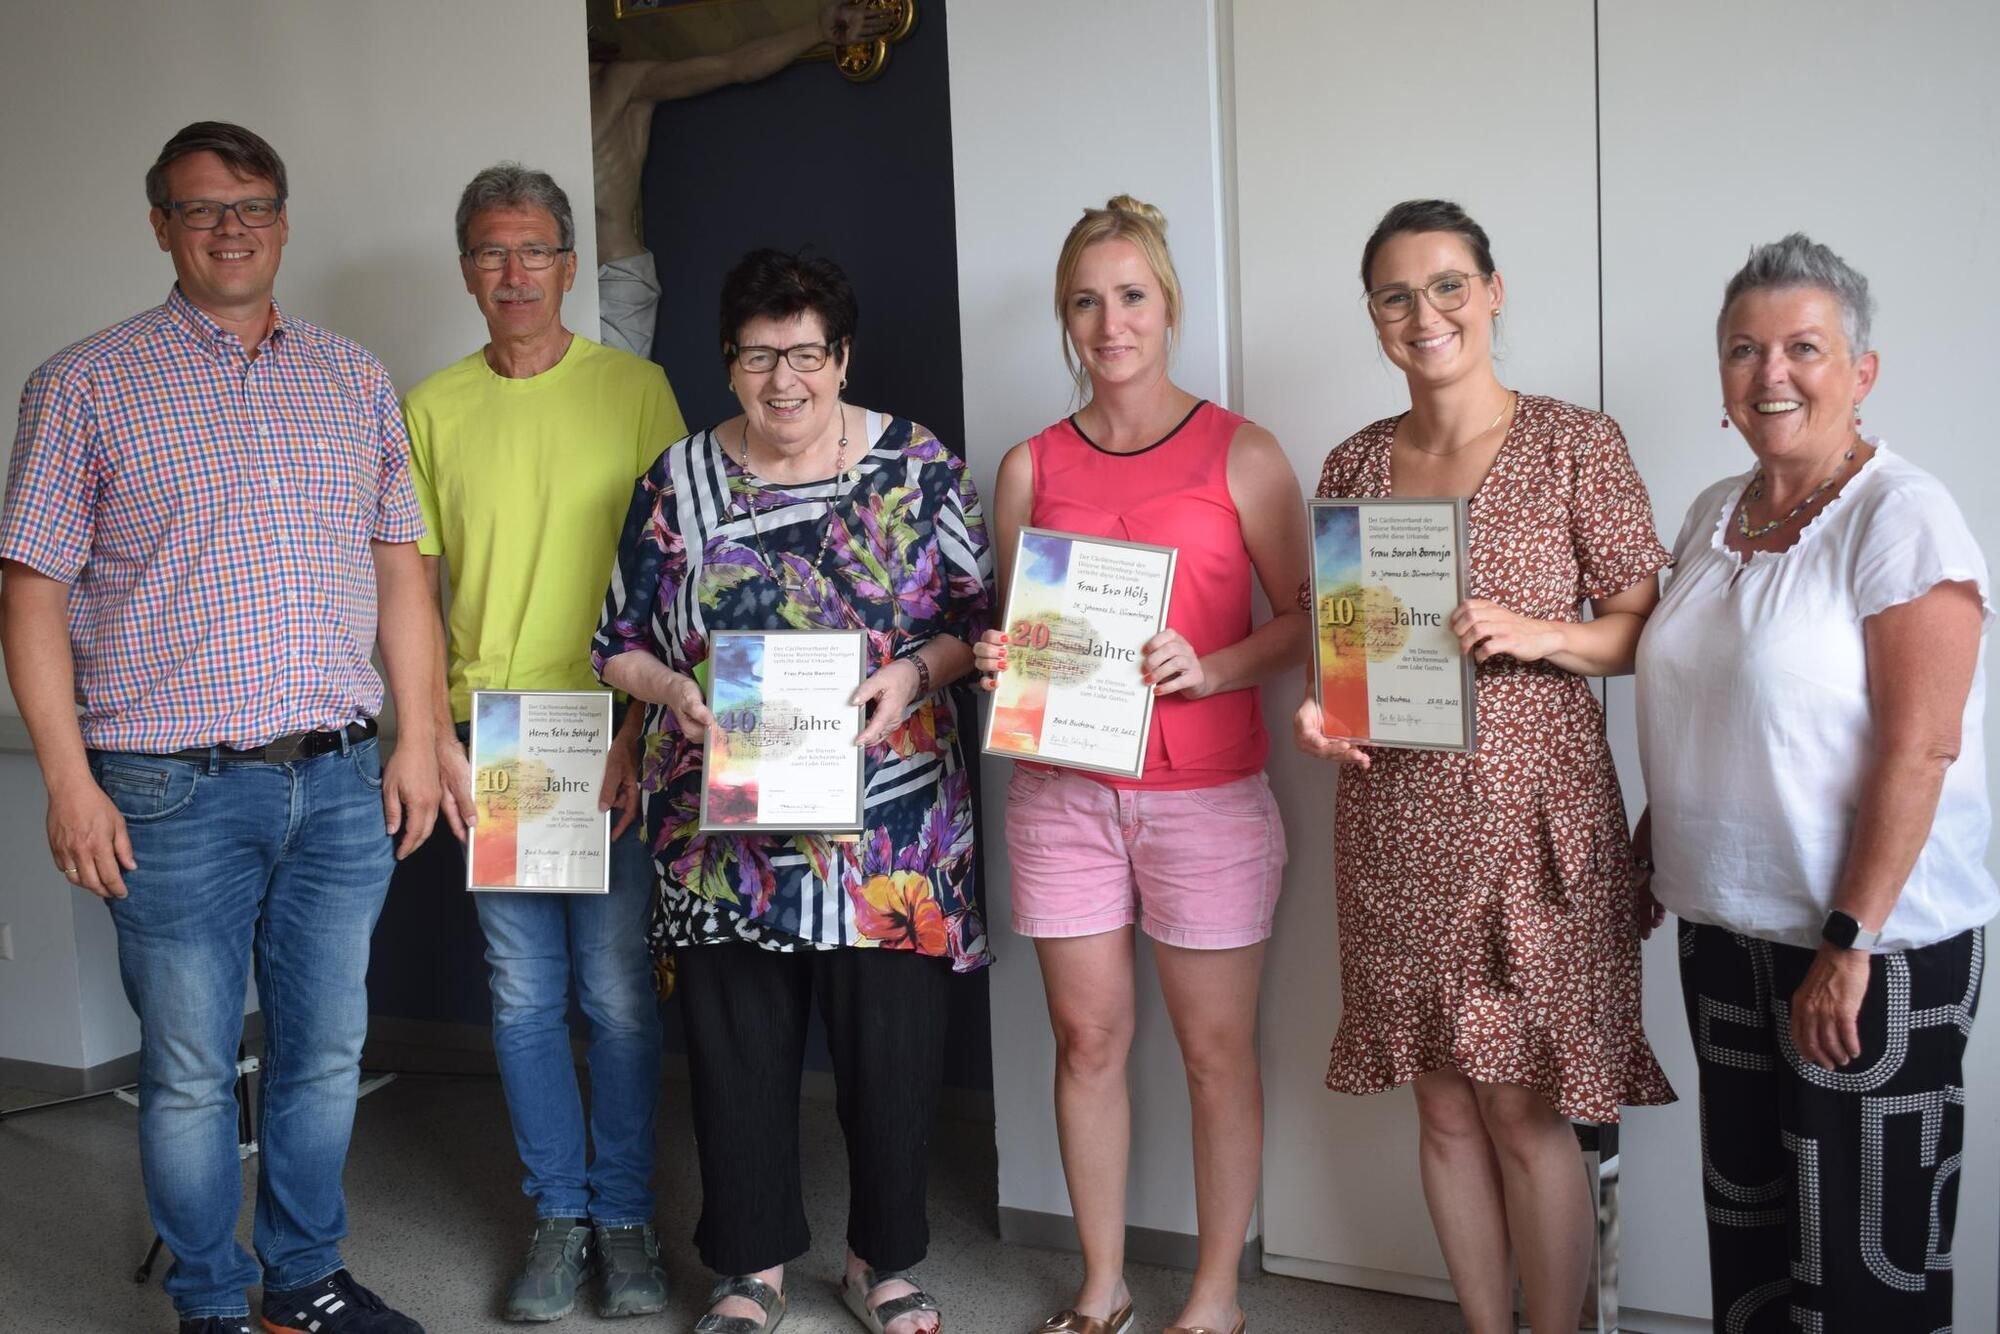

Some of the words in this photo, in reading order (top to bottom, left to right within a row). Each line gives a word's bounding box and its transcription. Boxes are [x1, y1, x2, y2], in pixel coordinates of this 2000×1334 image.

[1370, 546, 1388, 558] Frau
[1392, 547, 1417, 558] Sarah
[1077, 580, 1098, 592] Frau
[1102, 584, 1121, 595] Eva
[1124, 586, 1148, 606] Hölz
[1326, 597, 1354, 626] 10
[1391, 607, 1441, 627] Jahre
[1012, 619, 1050, 650] 20
[1083, 638, 1136, 662] Jahre
[719, 710, 756, 734] 40
[789, 715, 841, 731] Jahre
[529, 728, 549, 737] Herrn
[551, 728, 569, 737] Felix
[572, 728, 600, 742] Schlegel
[480, 768, 510, 793] 10
[543, 777, 590, 792] Jahre
